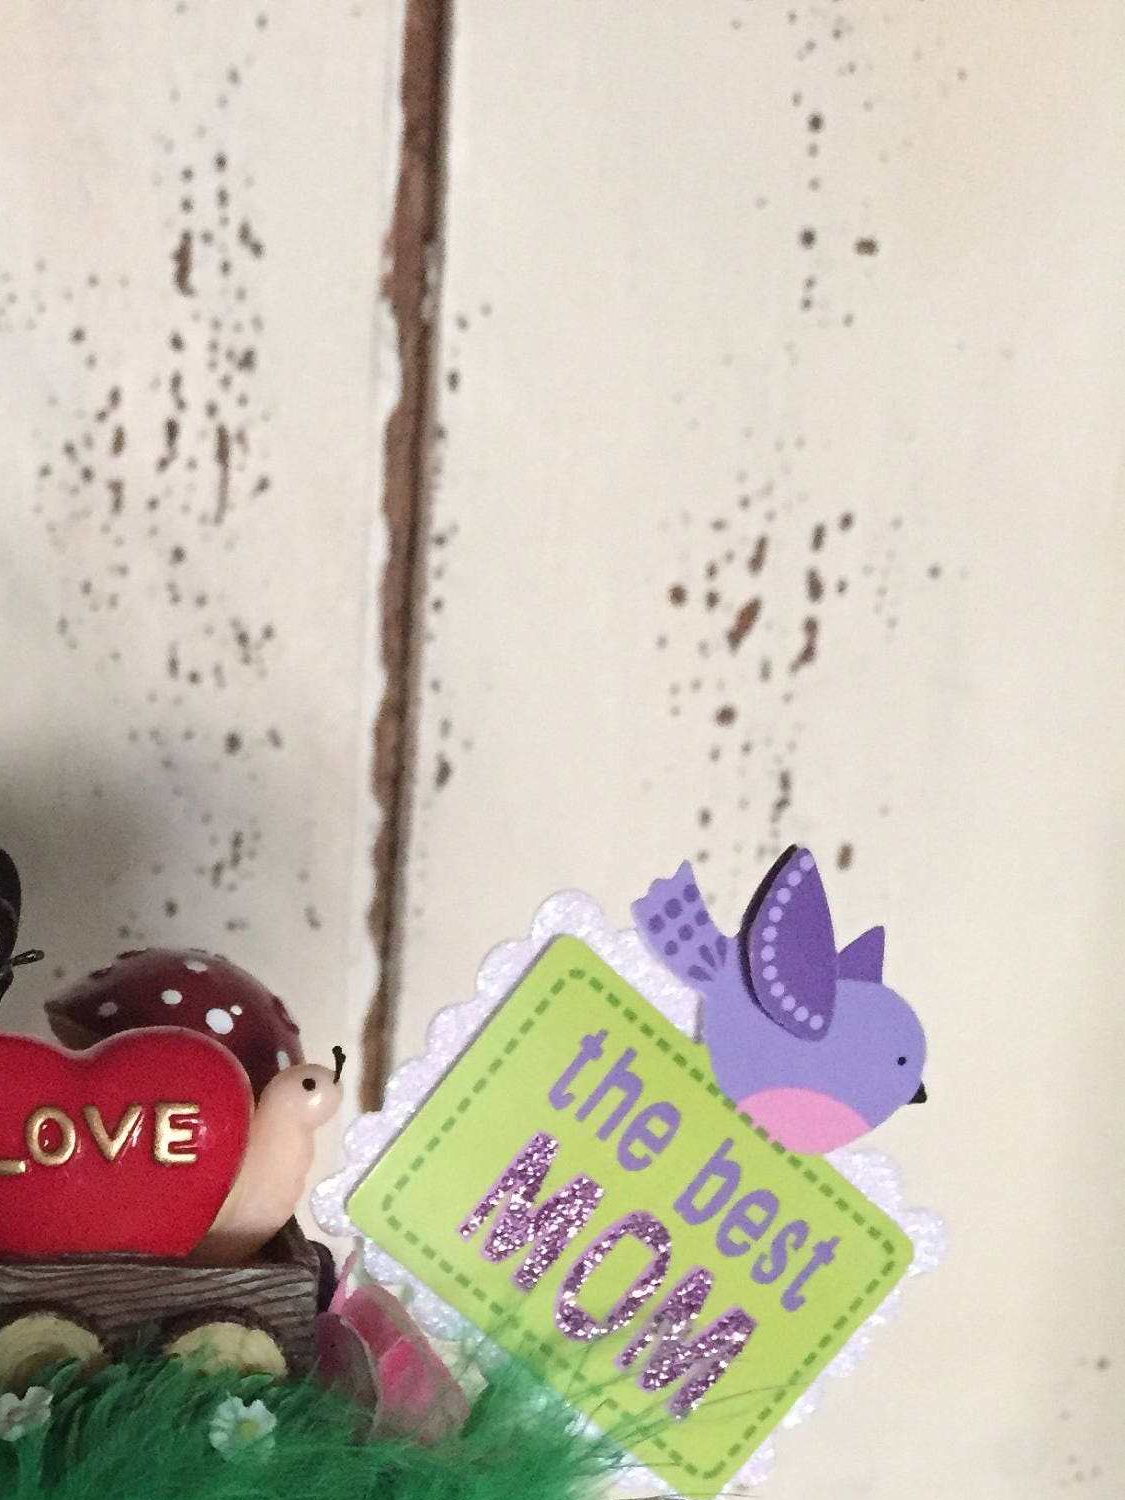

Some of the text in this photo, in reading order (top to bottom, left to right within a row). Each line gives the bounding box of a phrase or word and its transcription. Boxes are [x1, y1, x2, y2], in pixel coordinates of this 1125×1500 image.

[456, 1130, 760, 1422] MOM
[546, 1027, 843, 1314] the best
